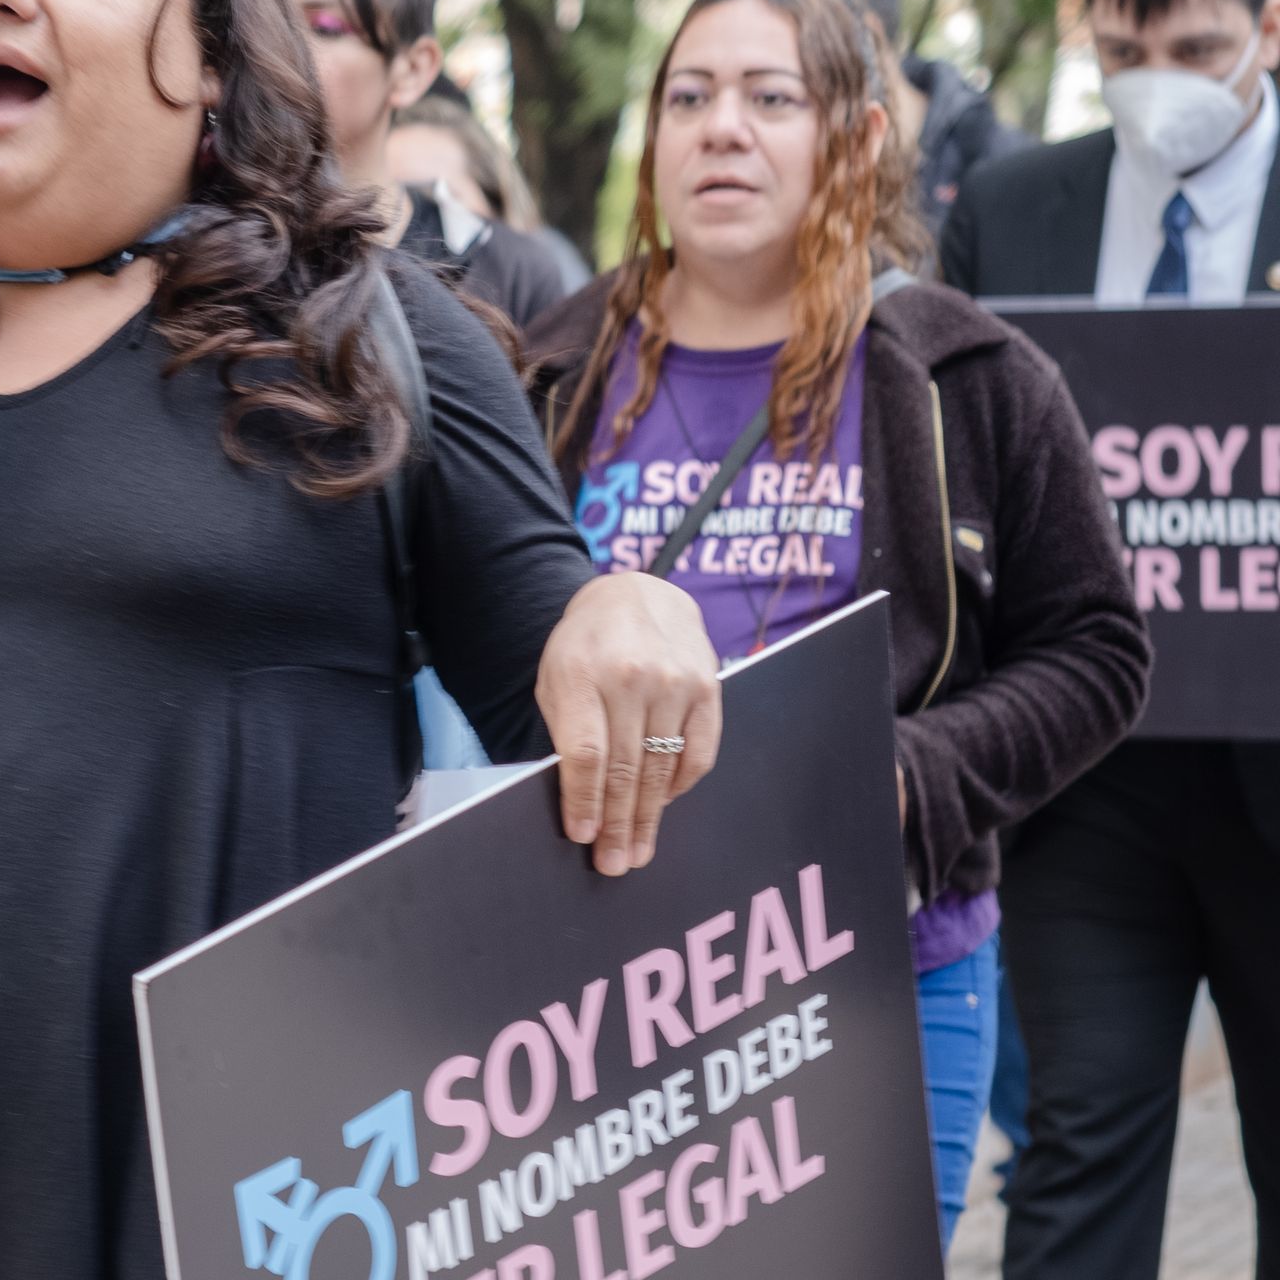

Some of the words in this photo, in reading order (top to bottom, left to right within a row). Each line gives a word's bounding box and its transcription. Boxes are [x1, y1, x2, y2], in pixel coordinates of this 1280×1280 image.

[747, 461, 864, 510] REAL
[1091, 424, 1249, 499] SOY
[621, 505, 659, 535] MI
[778, 505, 853, 537] DEBE
[1125, 497, 1280, 548] NOMBR
[699, 535, 835, 577] LEGAL
[422, 977, 609, 1177] SOY
[622, 863, 854, 1068] REAL
[478, 1069, 699, 1242] NOMBRE
[702, 994, 833, 1114] DEBE
